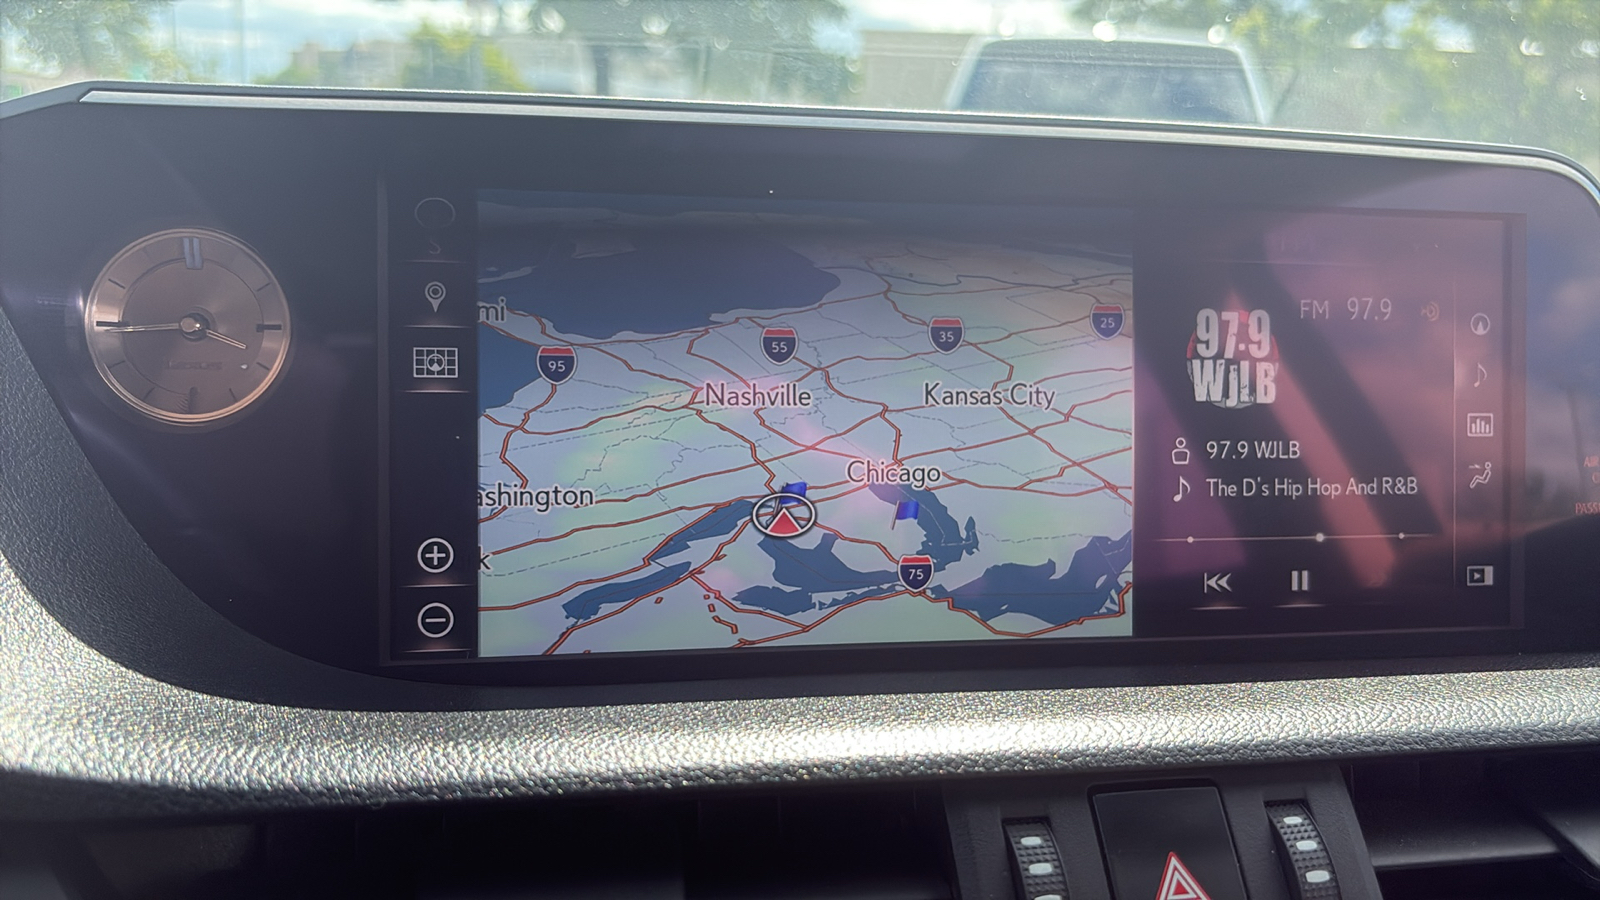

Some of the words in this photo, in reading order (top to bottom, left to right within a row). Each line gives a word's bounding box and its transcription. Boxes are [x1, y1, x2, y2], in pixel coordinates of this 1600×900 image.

[1300, 299, 1330, 320] FM
[1347, 297, 1393, 321] 97.9
[1100, 317, 1116, 329] 25
[1196, 308, 1271, 359] 97.9
[939, 330, 955, 343] 35
[771, 341, 788, 354] 55
[548, 360, 566, 372] 95
[704, 382, 812, 408] Nashville
[924, 382, 1003, 406] Kansas
[1009, 382, 1056, 411] City
[1206, 440, 1249, 459] 97.9
[1254, 440, 1300, 459] WJLB
[847, 460, 942, 488] Chicago
[1206, 478, 1237, 497] The
[1243, 477, 1269, 497] D's
[1274, 478, 1303, 500] Hip
[1307, 477, 1342, 499] Hop
[1345, 476, 1377, 495] And
[1382, 476, 1418, 495] R&B
[908, 569, 924, 580] 75
